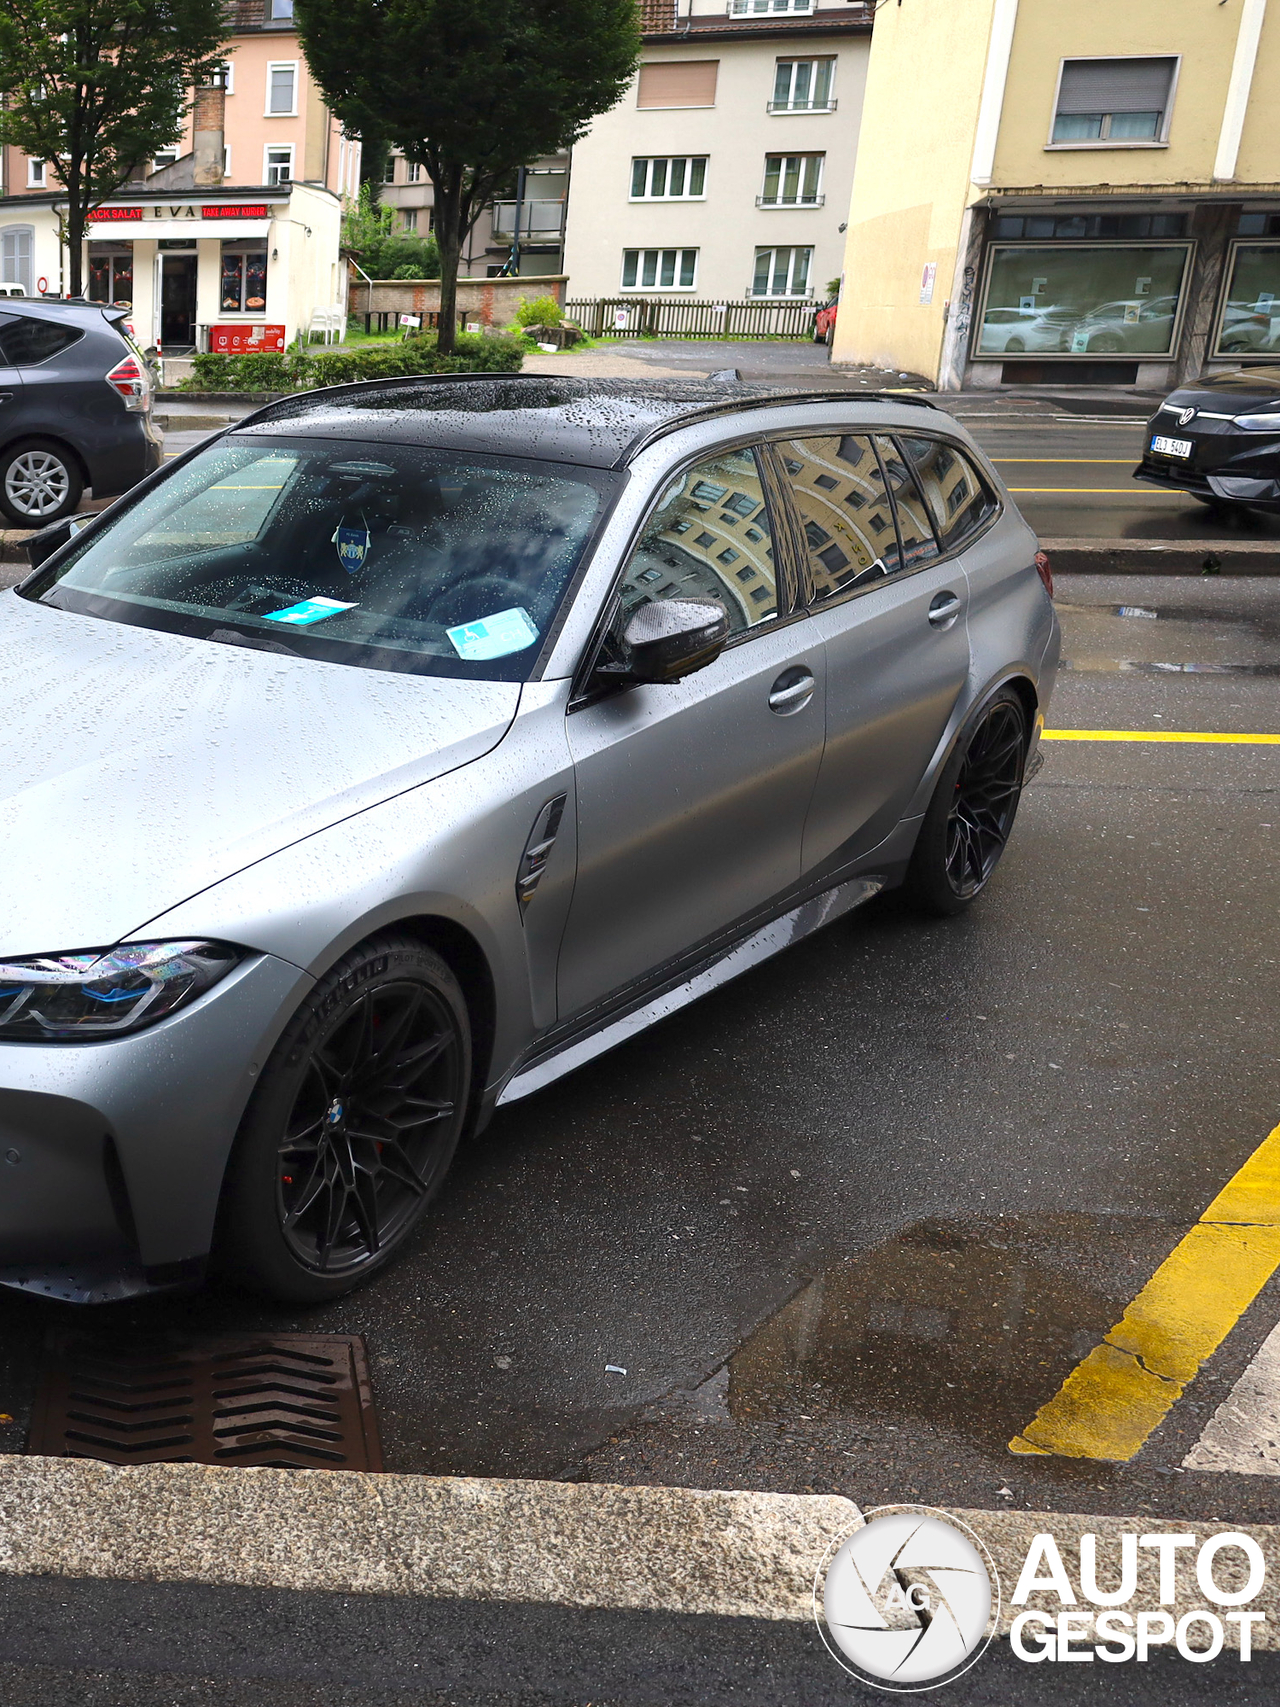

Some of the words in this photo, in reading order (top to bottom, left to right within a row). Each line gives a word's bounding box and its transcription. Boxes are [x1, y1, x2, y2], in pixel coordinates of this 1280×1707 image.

[111, 209, 143, 219] SALAT
[154, 205, 195, 217] EVA
[202, 207, 220, 217] TAKE
[220, 207, 240, 217] AWAY
